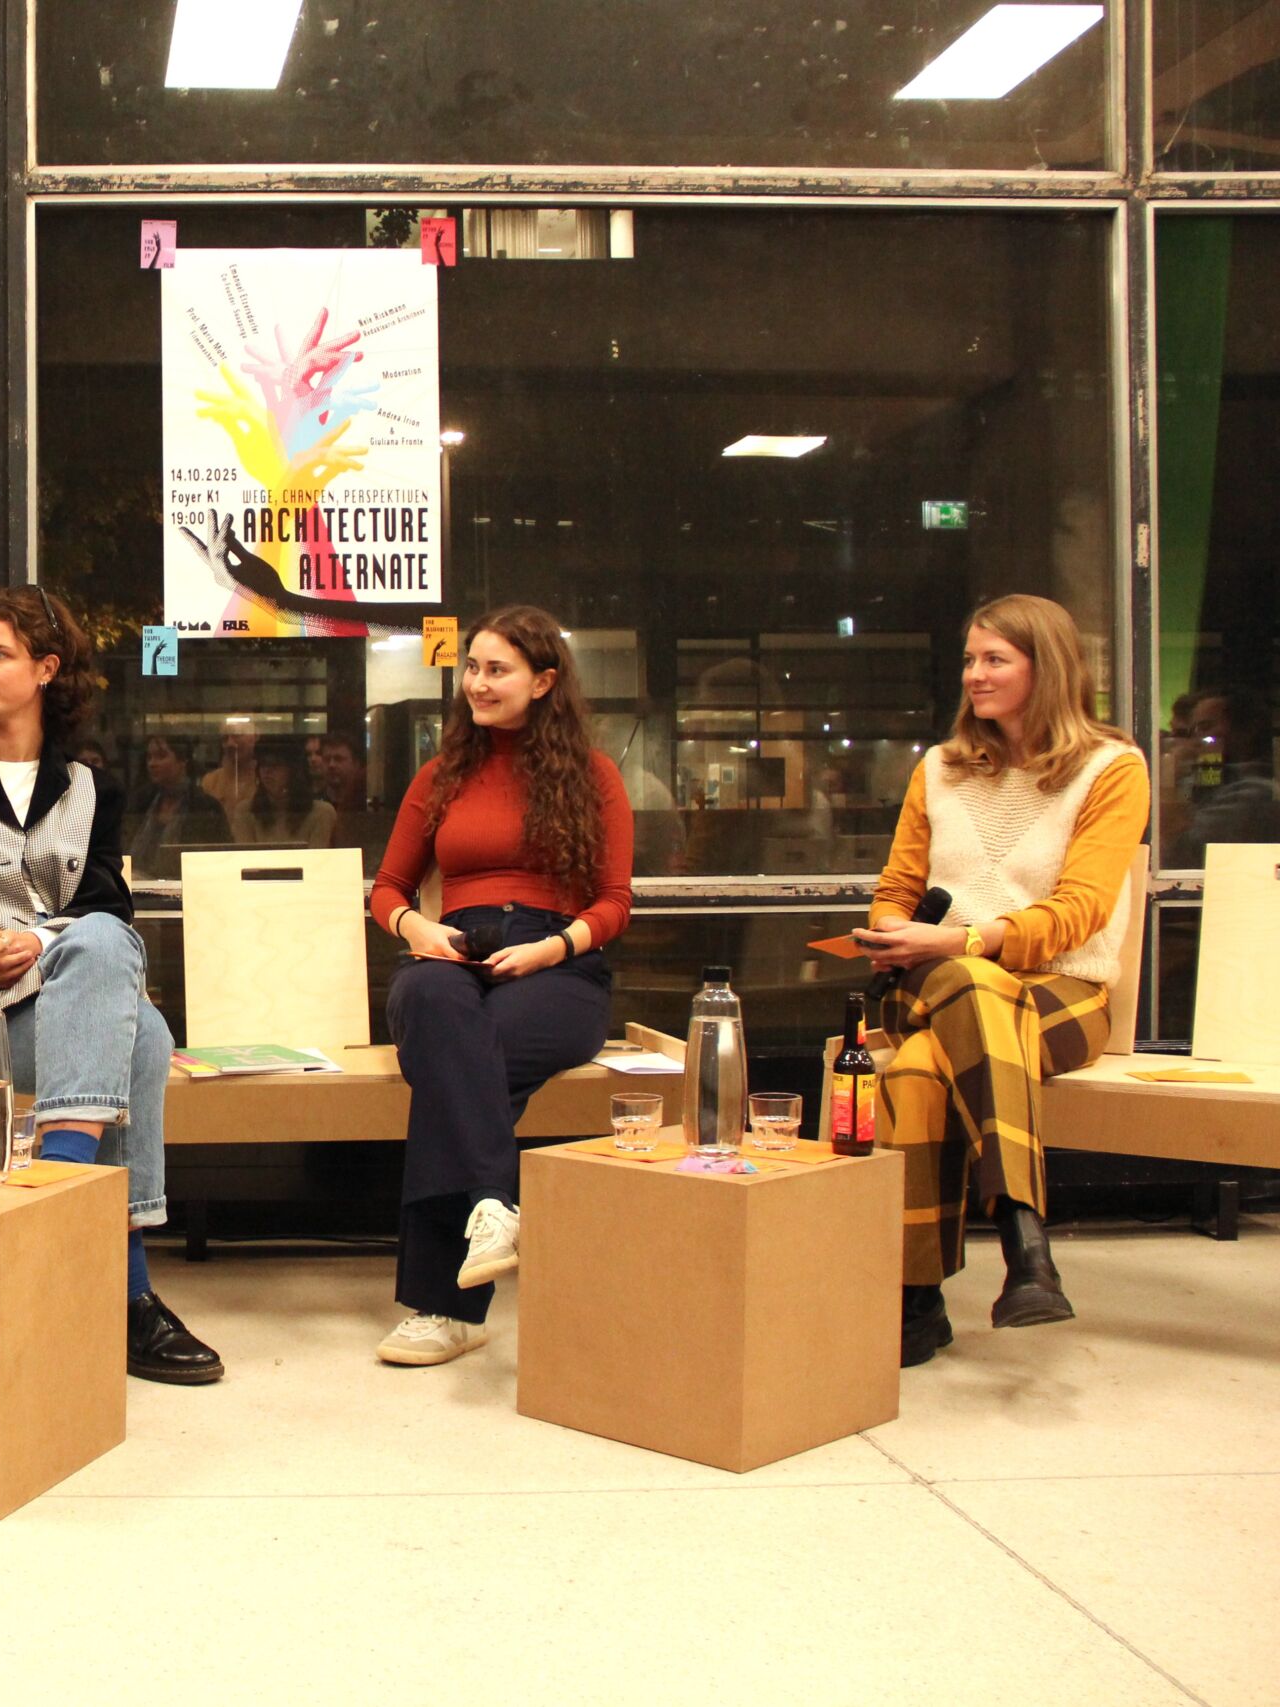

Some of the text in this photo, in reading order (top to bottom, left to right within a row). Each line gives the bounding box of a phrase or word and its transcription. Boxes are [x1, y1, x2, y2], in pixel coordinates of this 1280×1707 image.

[229, 264, 245, 293] Emanuel
[358, 303, 406, 327] Nele Rickmann
[199, 323, 215, 343] Maria
[213, 342, 228, 360] Mohr
[382, 368, 422, 379] Moderation
[377, 408, 420, 427] Andrea Irion
[389, 427, 395, 435] &
[370, 437, 423, 446] Giuliana Fronte
[171, 468, 237, 481] 14.10.2025
[171, 490, 220, 507] Foyer K1
[242, 489, 429, 506] WEGE, CHANCEN, PERSPEKTIVEN
[171, 511, 205, 525] 19:00
[243, 507, 429, 543] ARCHITECTURE
[299, 553, 429, 590] ALTERNATE
